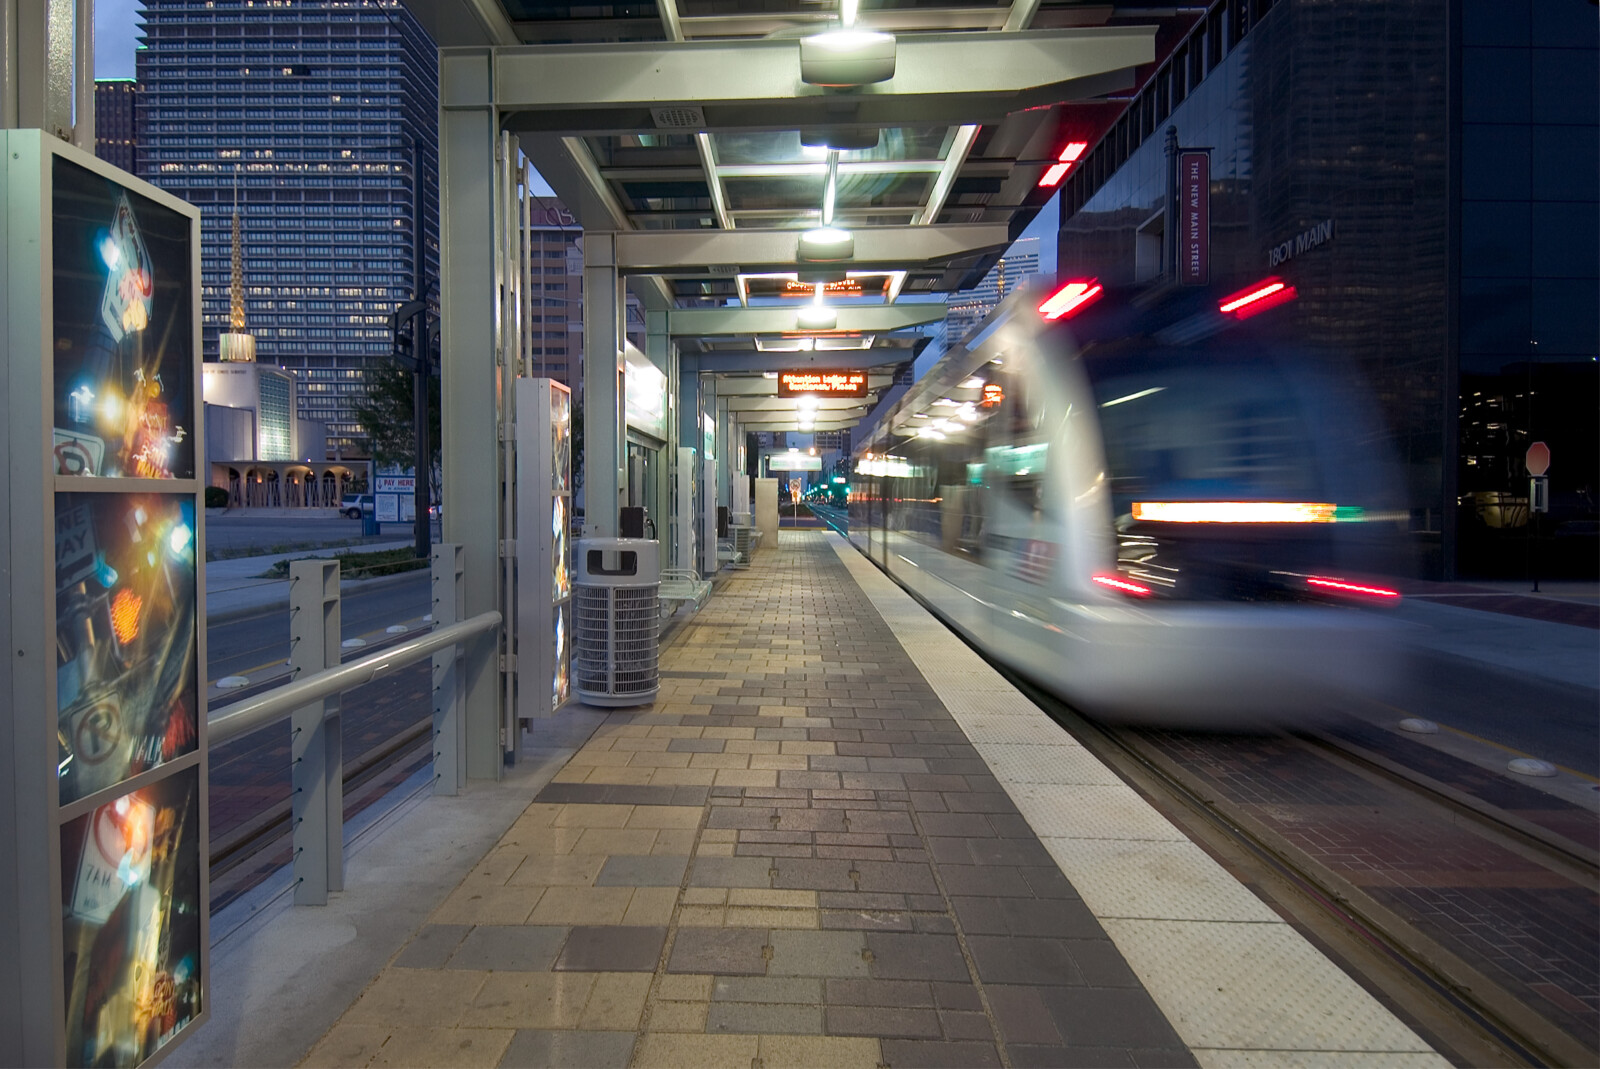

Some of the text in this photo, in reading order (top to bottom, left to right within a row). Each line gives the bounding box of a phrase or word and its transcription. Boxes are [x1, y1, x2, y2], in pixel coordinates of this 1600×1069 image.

[1190, 162, 1199, 277] THE NEW MAIN STREET
[1268, 219, 1333, 268] 1801 MAIN
[384, 479, 413, 487] PAY HERE
[57, 507, 86, 535] NE
